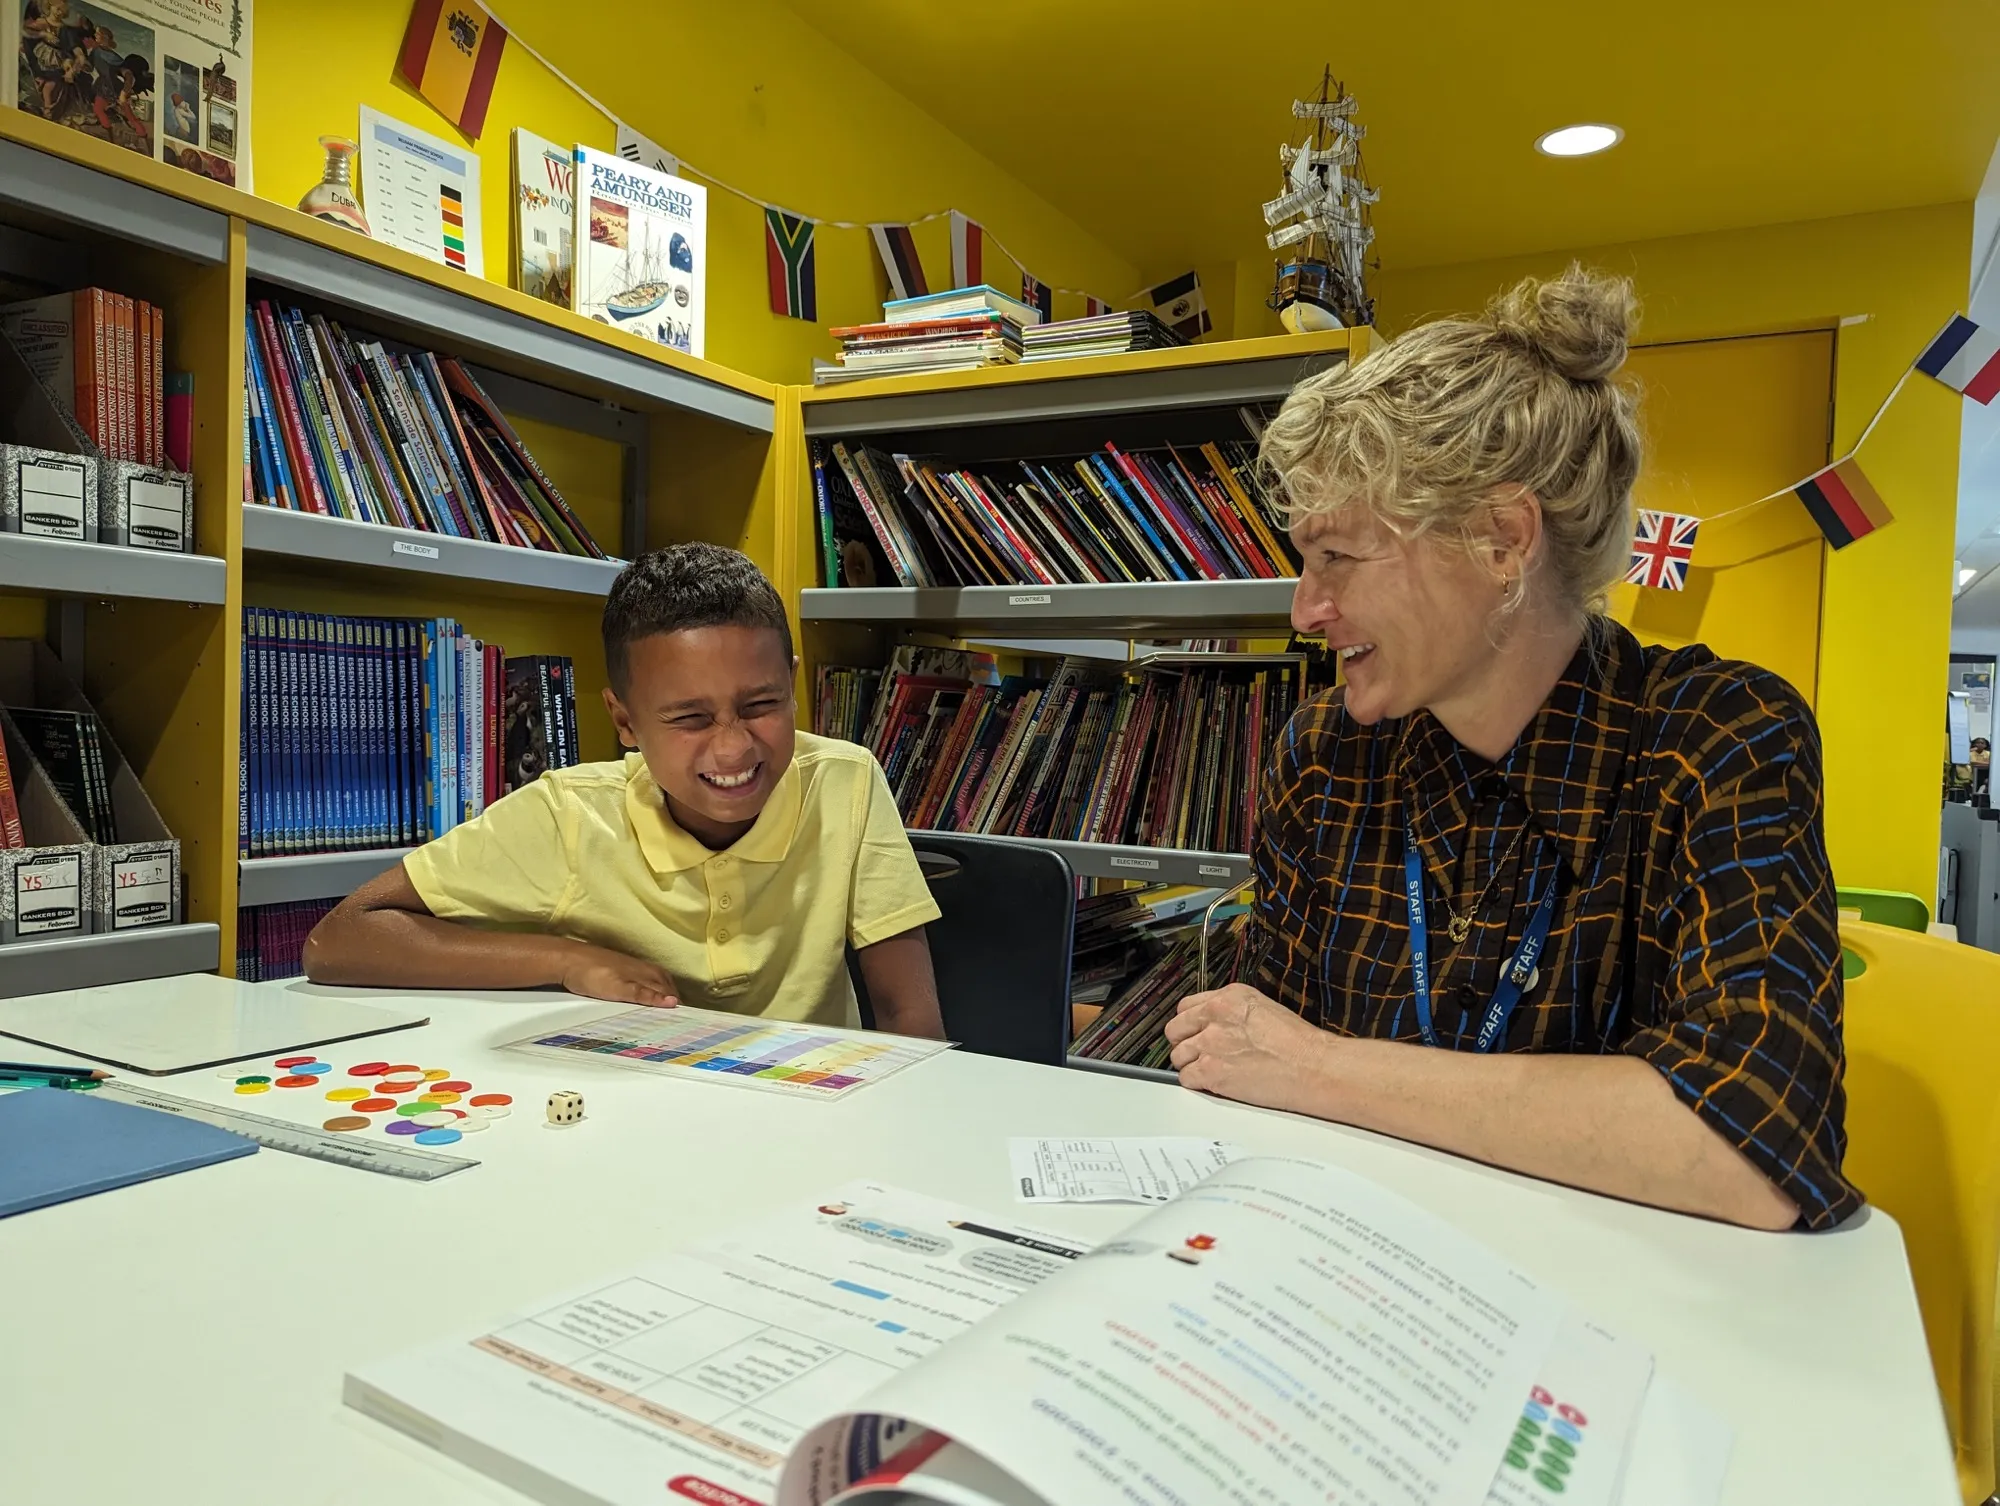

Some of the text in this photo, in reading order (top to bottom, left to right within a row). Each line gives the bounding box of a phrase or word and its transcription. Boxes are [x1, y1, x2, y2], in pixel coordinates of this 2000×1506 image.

[200, 12, 225, 27] PEOPLE
[591, 178, 692, 219] AMUNDSEN
[592, 164, 692, 206] PEARY AND
[96, 336, 104, 360] GREAT
[98, 387, 106, 421] LONDON
[108, 390, 116, 422] LONDON
[285, 386, 309, 456] EXERCISE AND YOUR BODY
[392, 388, 433, 479] See inside Science
[325, 417, 348, 474] HUMAN BODY
[522, 449, 544, 476] WORLD
[544, 476, 553, 490] OF
[552, 488, 571, 513] CITIES
[25, 515, 60, 525] BANKERS
[1228, 500, 1242, 519] EUROPE
[133, 527, 163, 536] BANKERS
[852, 478, 903, 573] SCIENCE EXPERIMENTS
[414, 546, 431, 554] BODY
[280, 652, 288, 694] ESSENTIAL
[310, 654, 318, 695] ESSENTIAL
[540, 665, 550, 707] BEAUTIFUL
[554, 694, 564, 727] WHAT
[994, 691, 1003, 704] 100
[544, 712, 553, 743] BRITAIN
[558, 730, 565, 746] ON
[442, 768, 448, 778] UK
[450, 767, 456, 778] UK
[1407, 822, 1417, 853] AFF
[24, 876, 42, 890] Y5
[119, 872, 137, 888] Y5
[22, 912, 56, 920] BANKERS
[118, 907, 149, 915] BANKERS
[1410, 881, 1421, 924] STAFF
[48, 920, 74, 928] Fellowes
[1514, 936, 1539, 975] TAFF
[1414, 952, 1425, 996] STAFF
[1478, 1003, 1504, 1048] STAFF
